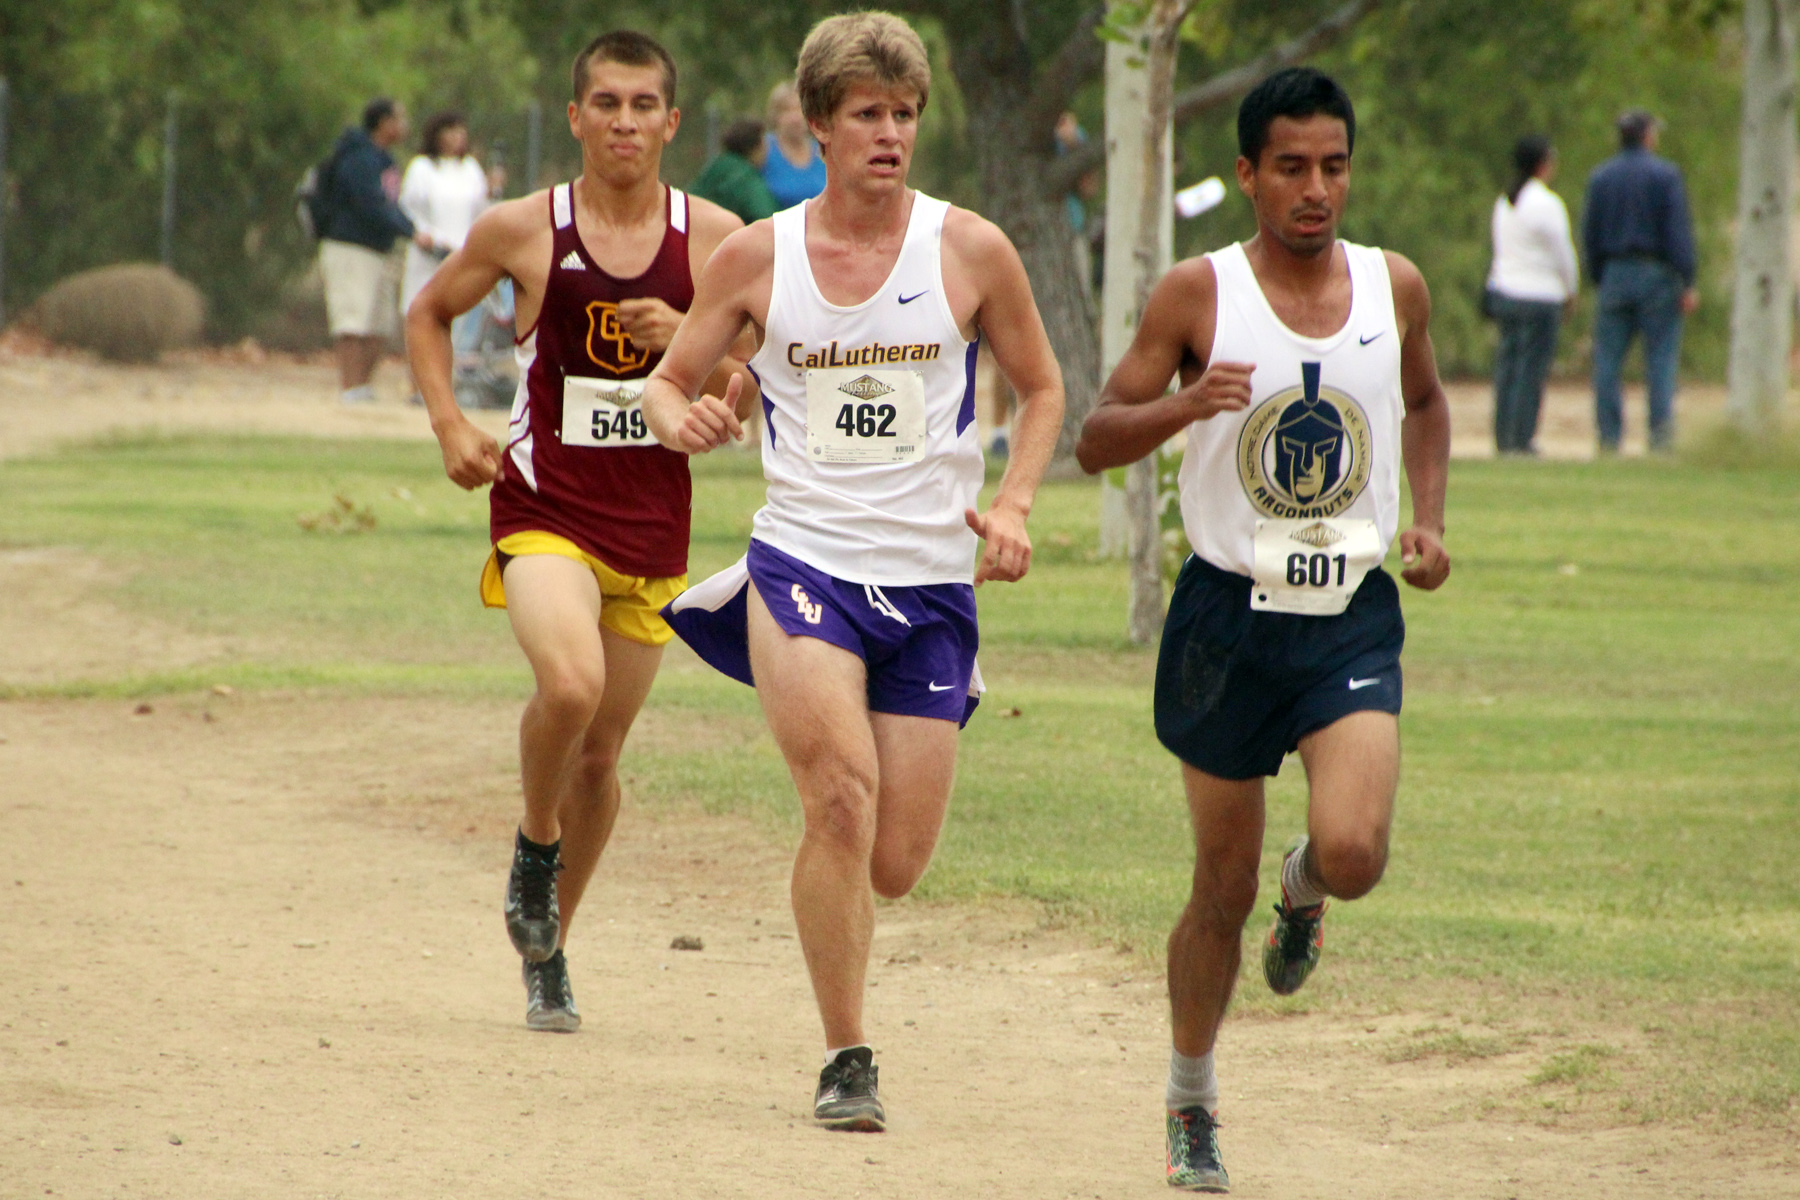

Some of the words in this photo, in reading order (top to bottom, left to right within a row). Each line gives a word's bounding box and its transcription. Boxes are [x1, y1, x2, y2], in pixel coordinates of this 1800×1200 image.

[840, 382, 893, 393] MUSTANG
[591, 408, 648, 440] 549
[836, 403, 897, 438] 462
[1253, 486, 1354, 519] ARGONAUTS
[1286, 553, 1347, 587] 601
